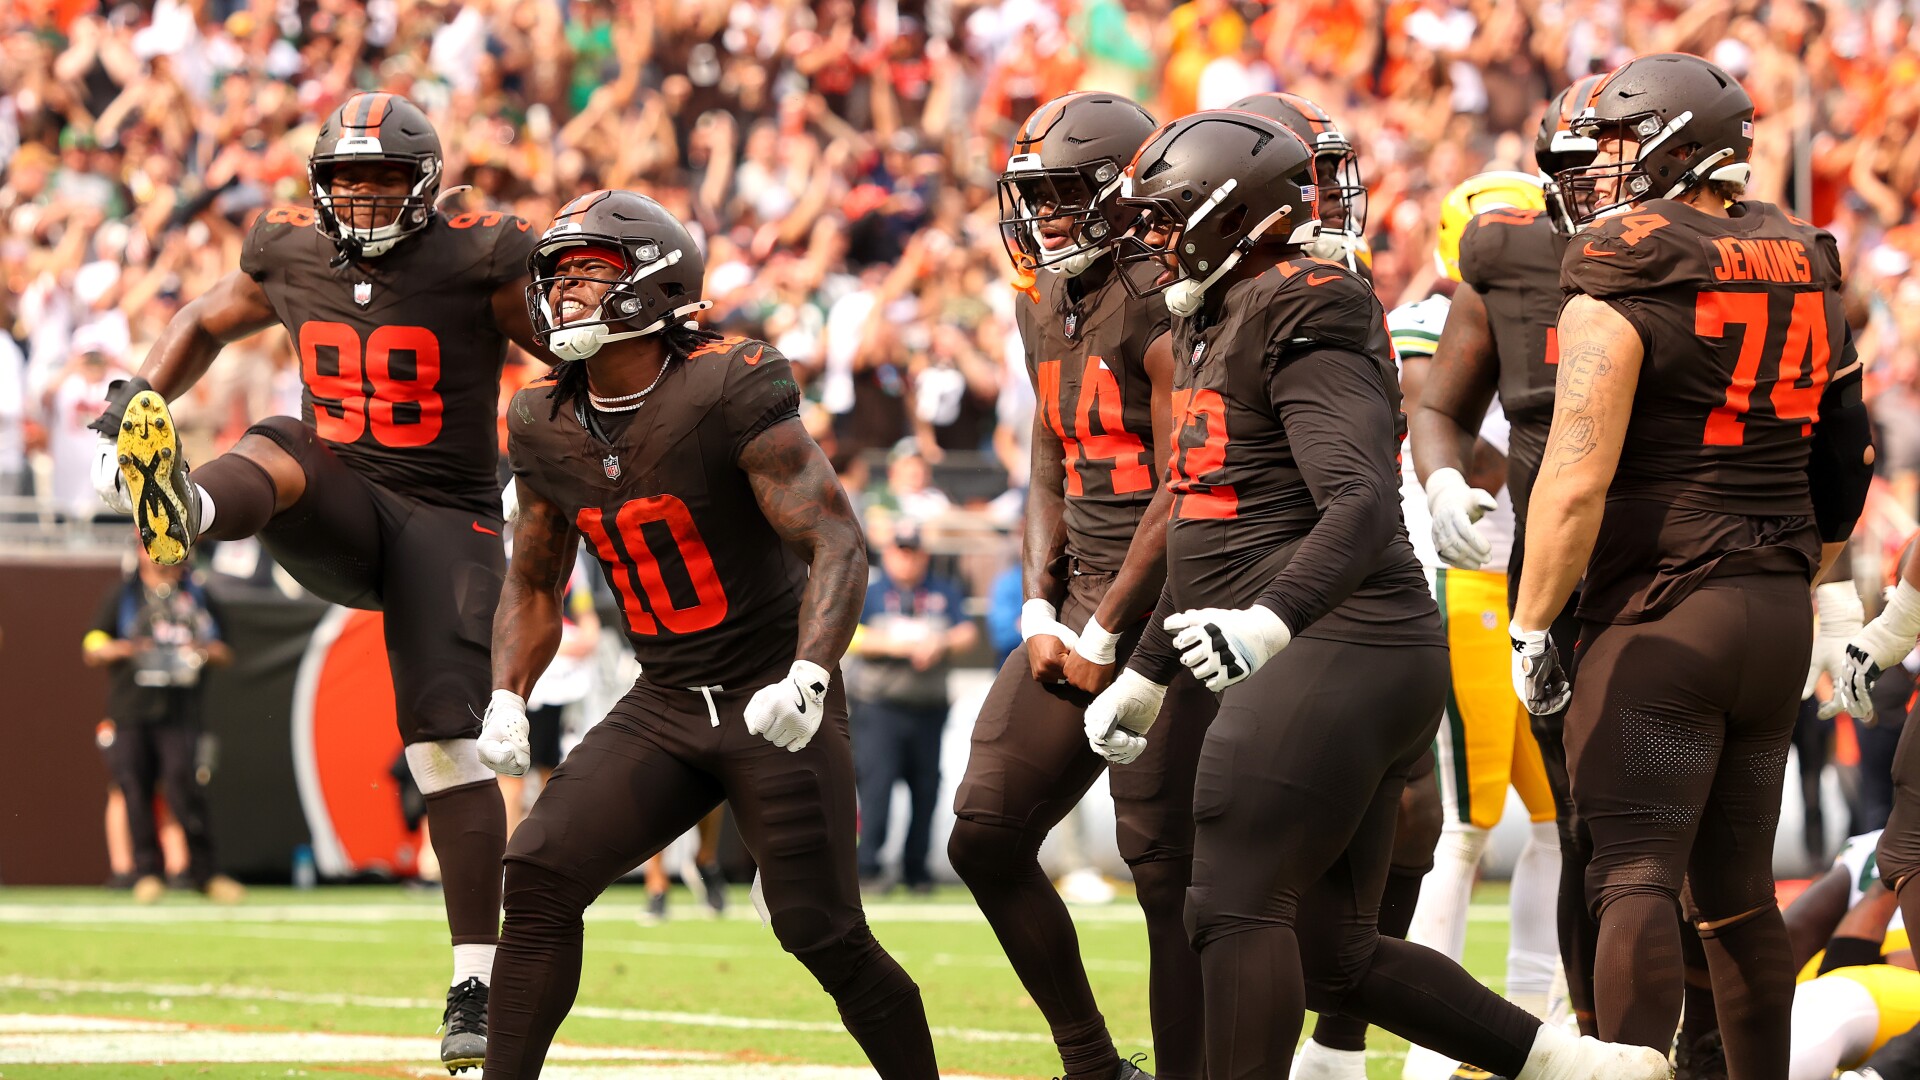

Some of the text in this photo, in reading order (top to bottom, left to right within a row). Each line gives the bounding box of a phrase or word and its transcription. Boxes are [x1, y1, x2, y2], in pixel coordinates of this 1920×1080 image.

[1711, 237, 1811, 283] JENKINS
[299, 320, 444, 448] 98
[1695, 291, 1831, 446] 74
[576, 494, 728, 635] 10
